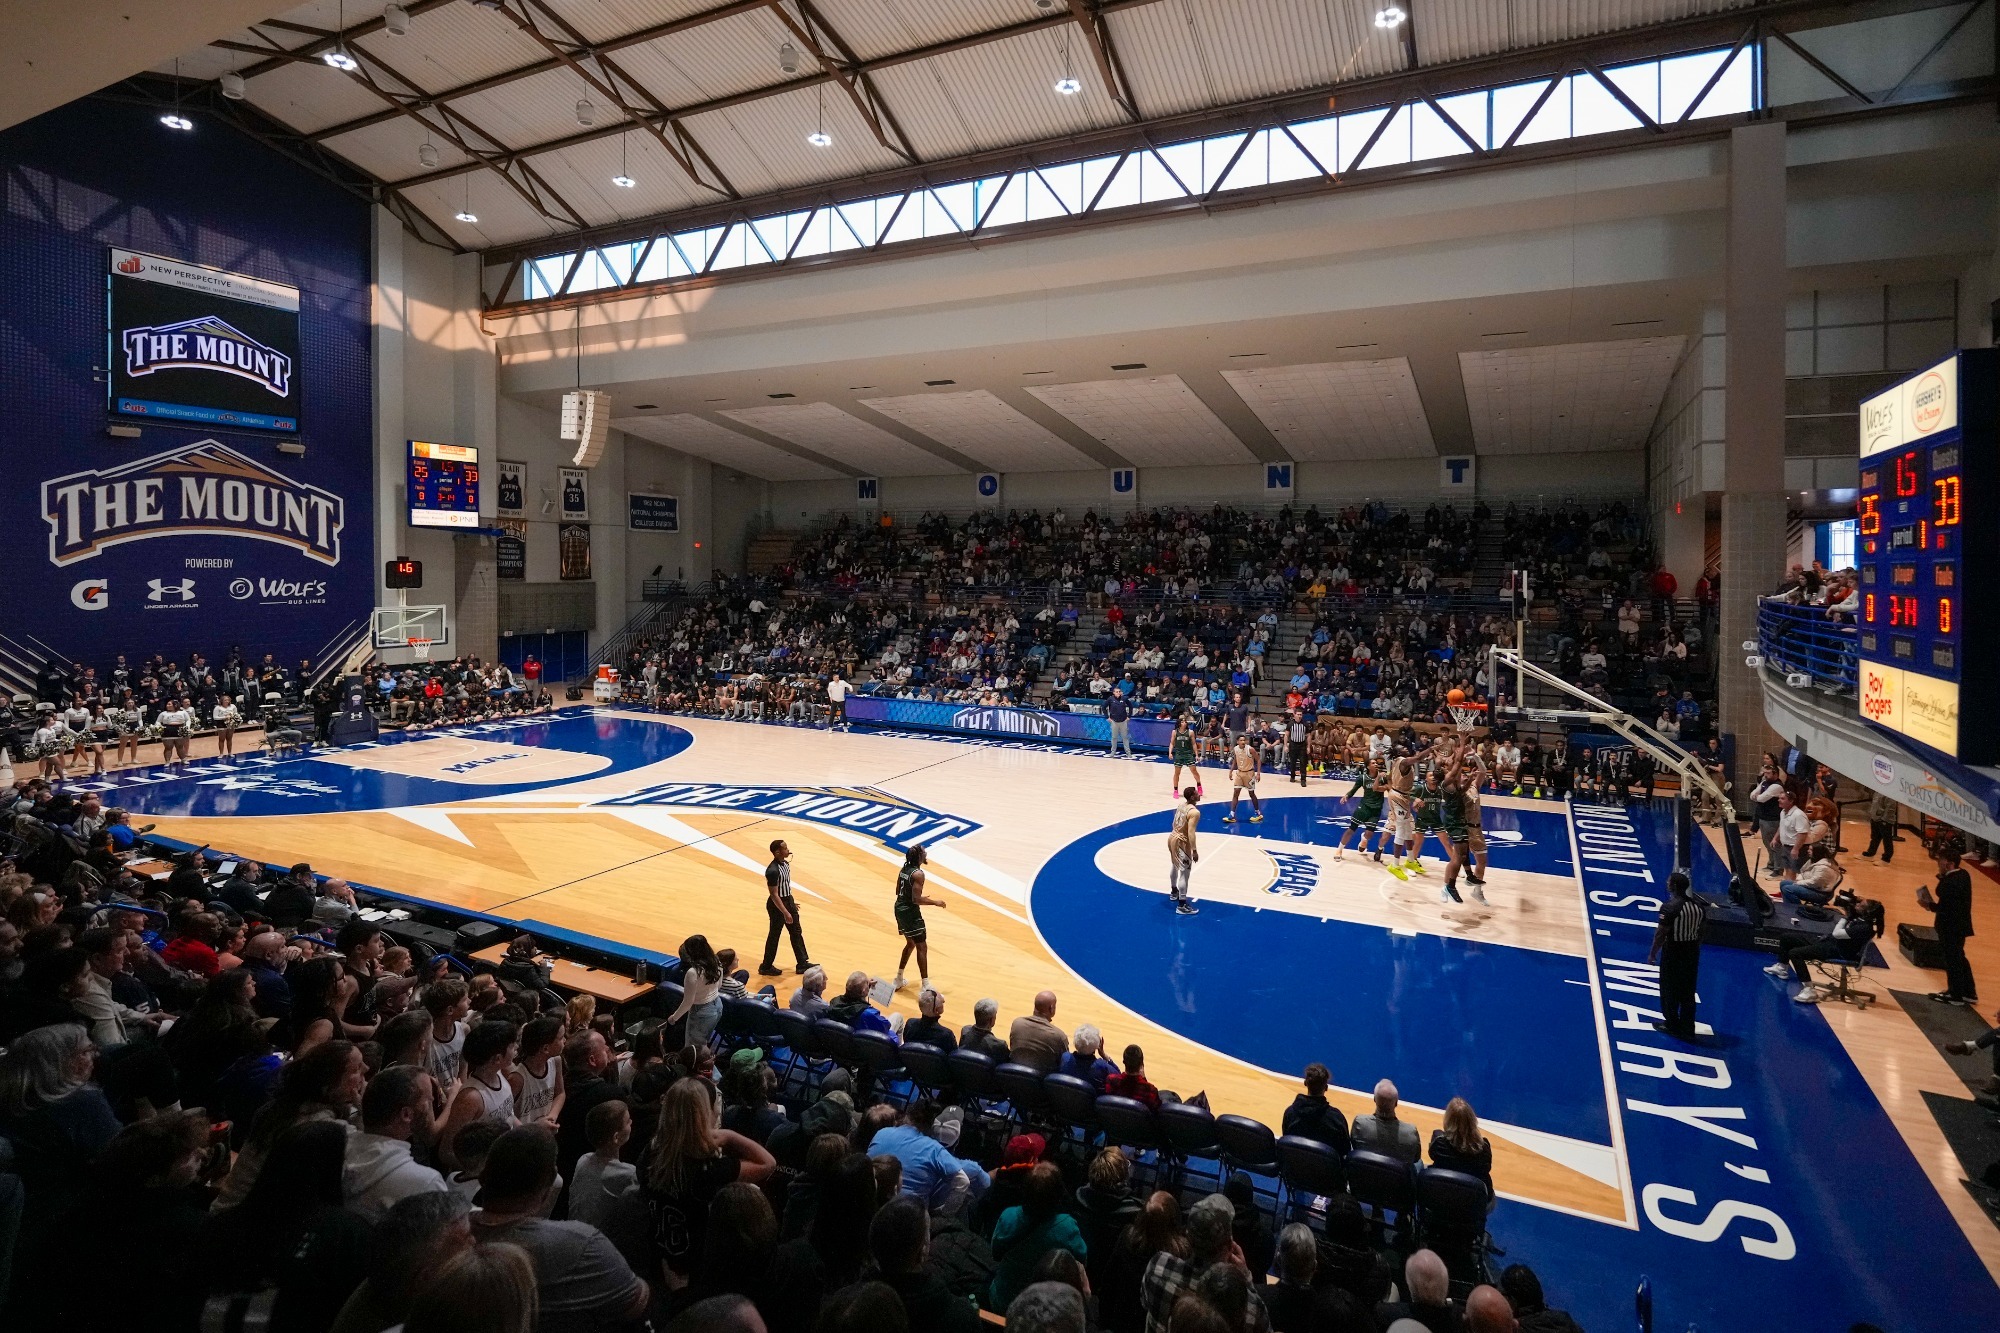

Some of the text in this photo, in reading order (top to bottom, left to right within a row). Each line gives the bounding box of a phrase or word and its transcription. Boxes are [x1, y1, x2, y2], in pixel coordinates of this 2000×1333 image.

[150, 263, 172, 276] NEW
[174, 269, 232, 288] PERSPECTIVE
[130, 332, 286, 388] THE MOUNT
[414, 466, 429, 478] 25
[465, 470, 478, 482] 33
[503, 491, 516, 503] 24
[568, 493, 580, 504] 35
[1934, 475, 1960, 527] 33
[57, 476, 334, 550] THE MOUNT
[185, 558, 234, 569] POWERED BY
[399, 562, 413, 573] 1.6
[70, 578, 109, 611] G
[1868, 671, 1884, 698] Roy
[1864, 693, 1892, 721] Rogers
[957, 708, 1056, 737] THE MOUNT
[601, 783, 973, 850] THE MOUNT
[1899, 777, 1989, 827] SPORTS COMPLEX
[1572, 803, 1656, 883] MOUNT
[1267, 848, 1323, 898] MAAC
[1601, 957, 1798, 1261] MARY'S
